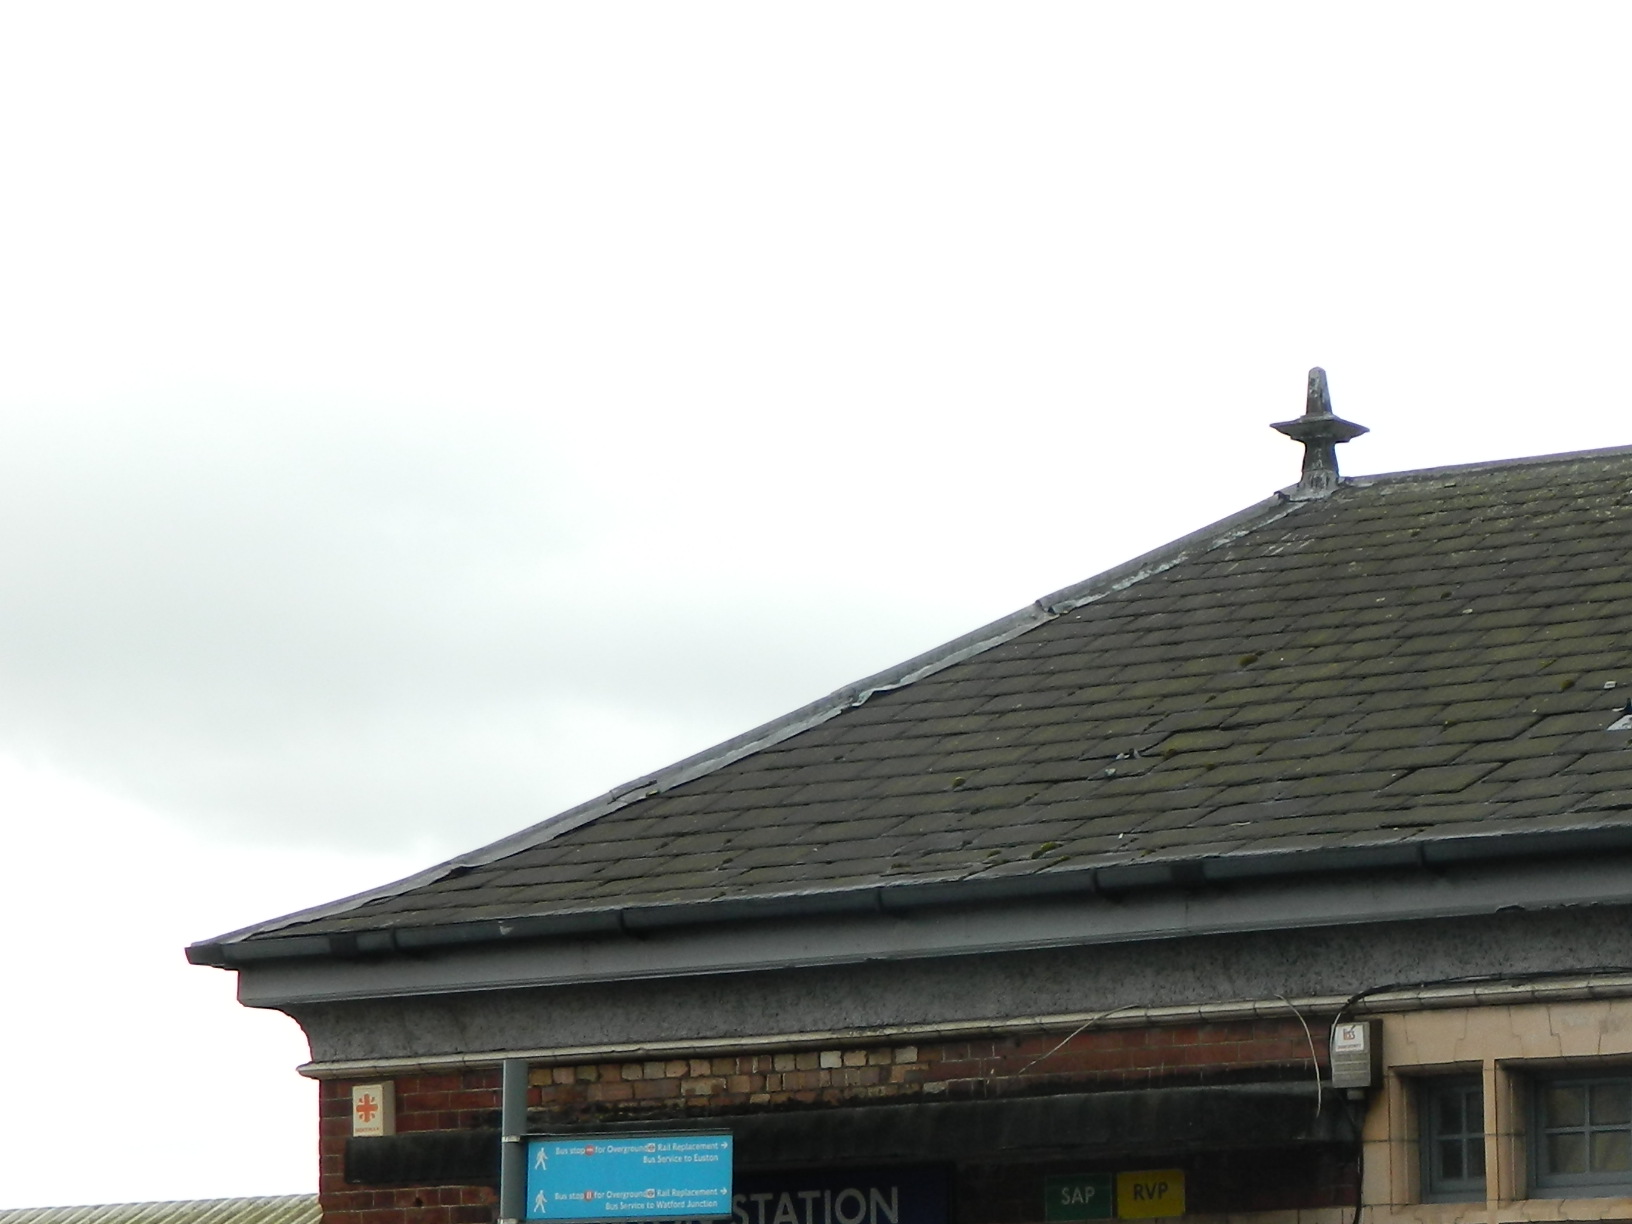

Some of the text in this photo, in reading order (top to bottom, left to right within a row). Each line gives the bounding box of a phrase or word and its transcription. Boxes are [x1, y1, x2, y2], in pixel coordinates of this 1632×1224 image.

[555, 1147, 568, 1155] Bus
[569, 1146, 585, 1156] stop
[595, 1145, 605, 1154] for
[658, 1143, 671, 1151] Rail
[672, 1142, 718, 1151] Replacement
[643, 1155, 656, 1163] Bus
[657, 1155, 682, 1163] Service
[694, 1154, 718, 1162] Euston
[555, 1192, 567, 1200] Bus
[594, 1191, 605, 1199] for
[657, 1188, 670, 1196] Rail
[672, 1187, 717, 1197] Replacement
[1061, 1186, 1095, 1205] SAP
[1134, 1181, 1169, 1200] RVP
[605, 1202, 618, 1210] Bus
[620, 1201, 644, 1210] Service
[656, 1200, 685, 1209] Watford
[687, 1200, 717, 1208] Junction
